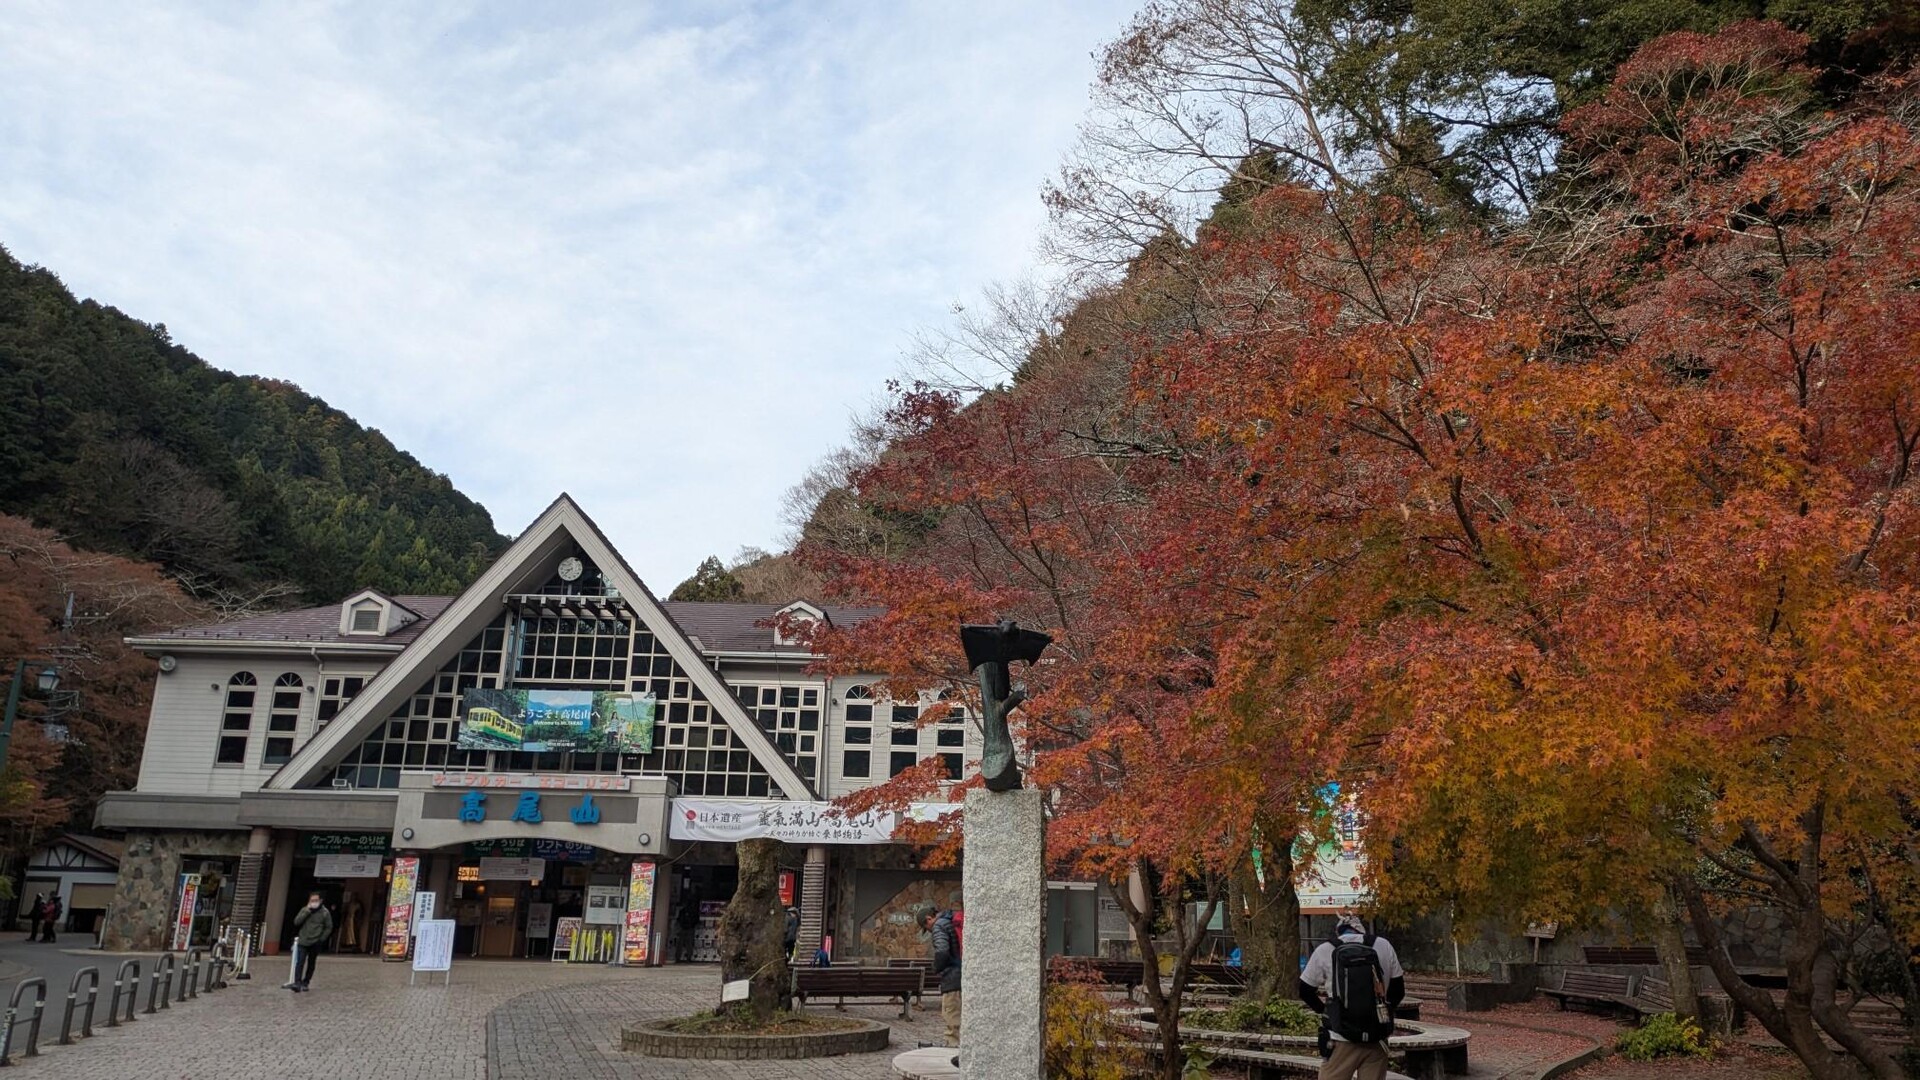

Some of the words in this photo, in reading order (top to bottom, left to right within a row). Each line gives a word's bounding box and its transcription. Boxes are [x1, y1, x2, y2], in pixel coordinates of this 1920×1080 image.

[434, 773, 522, 787] ケーブルカー
[539, 776, 626, 789] エコーリフト
[458, 790, 601, 825] 高尾山
[700, 812, 742, 823] 日本遺産
[312, 834, 386, 845] ケーブルカーのりば
[536, 839, 563, 850] リフト
